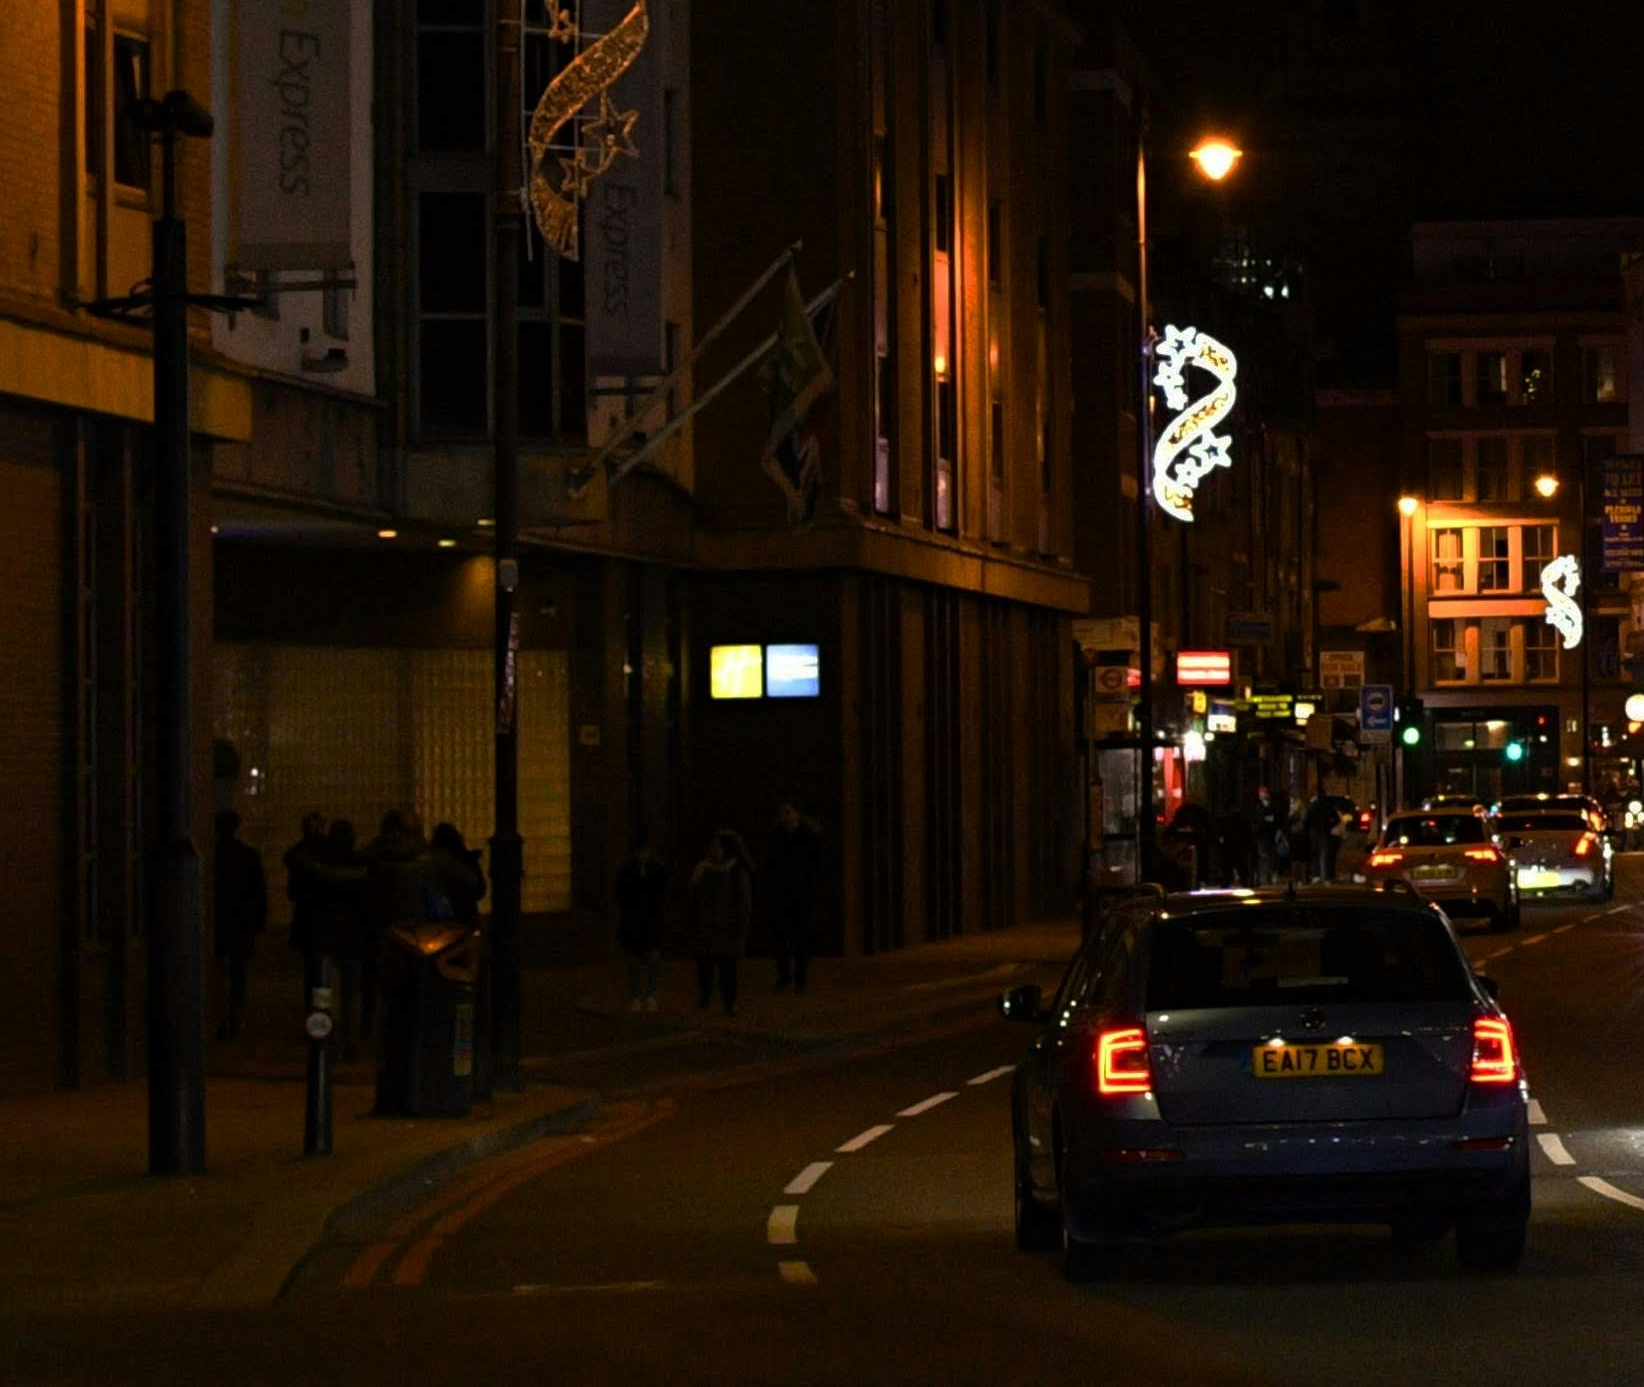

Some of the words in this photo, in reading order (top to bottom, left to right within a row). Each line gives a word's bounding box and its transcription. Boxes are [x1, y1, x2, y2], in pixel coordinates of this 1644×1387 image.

[269, 29, 320, 197] Express
[599, 180, 639, 315] Express
[1263, 1049, 1317, 1072] EA17
[1327, 1048, 1374, 1070] BCX
